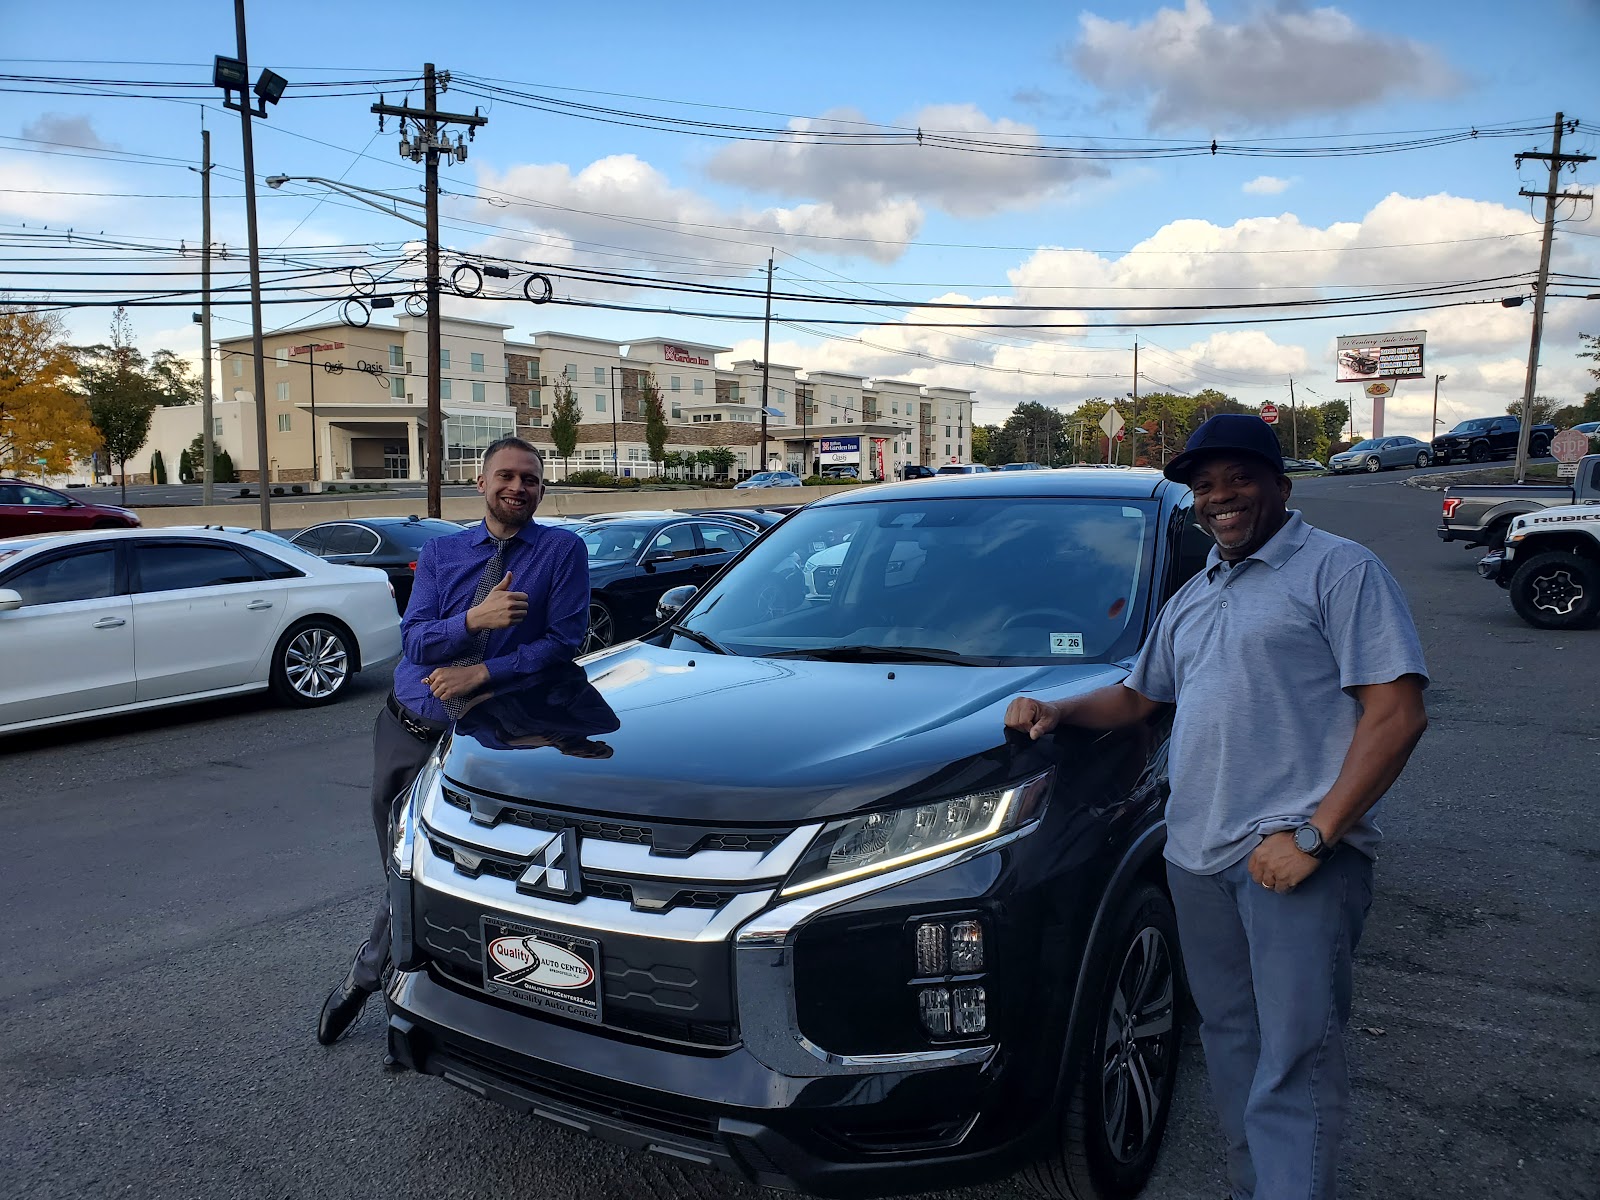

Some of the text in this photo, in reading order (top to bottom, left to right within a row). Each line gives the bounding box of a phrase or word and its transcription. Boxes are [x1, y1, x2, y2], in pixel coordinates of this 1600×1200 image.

[1397, 335, 1419, 343] Group
[357, 360, 383, 372] Oasis
[674, 353, 698, 364] Garden
[698, 356, 709, 366] Inn
[1553, 440, 1585, 453] STOP
[832, 453, 847, 462] Oasis
[1056, 638, 1079, 647] 2 26
[497, 943, 529, 964] Quality
[541, 958, 588, 976] AUTO CENTER
[512, 990, 598, 1020] Quality Auto Center
